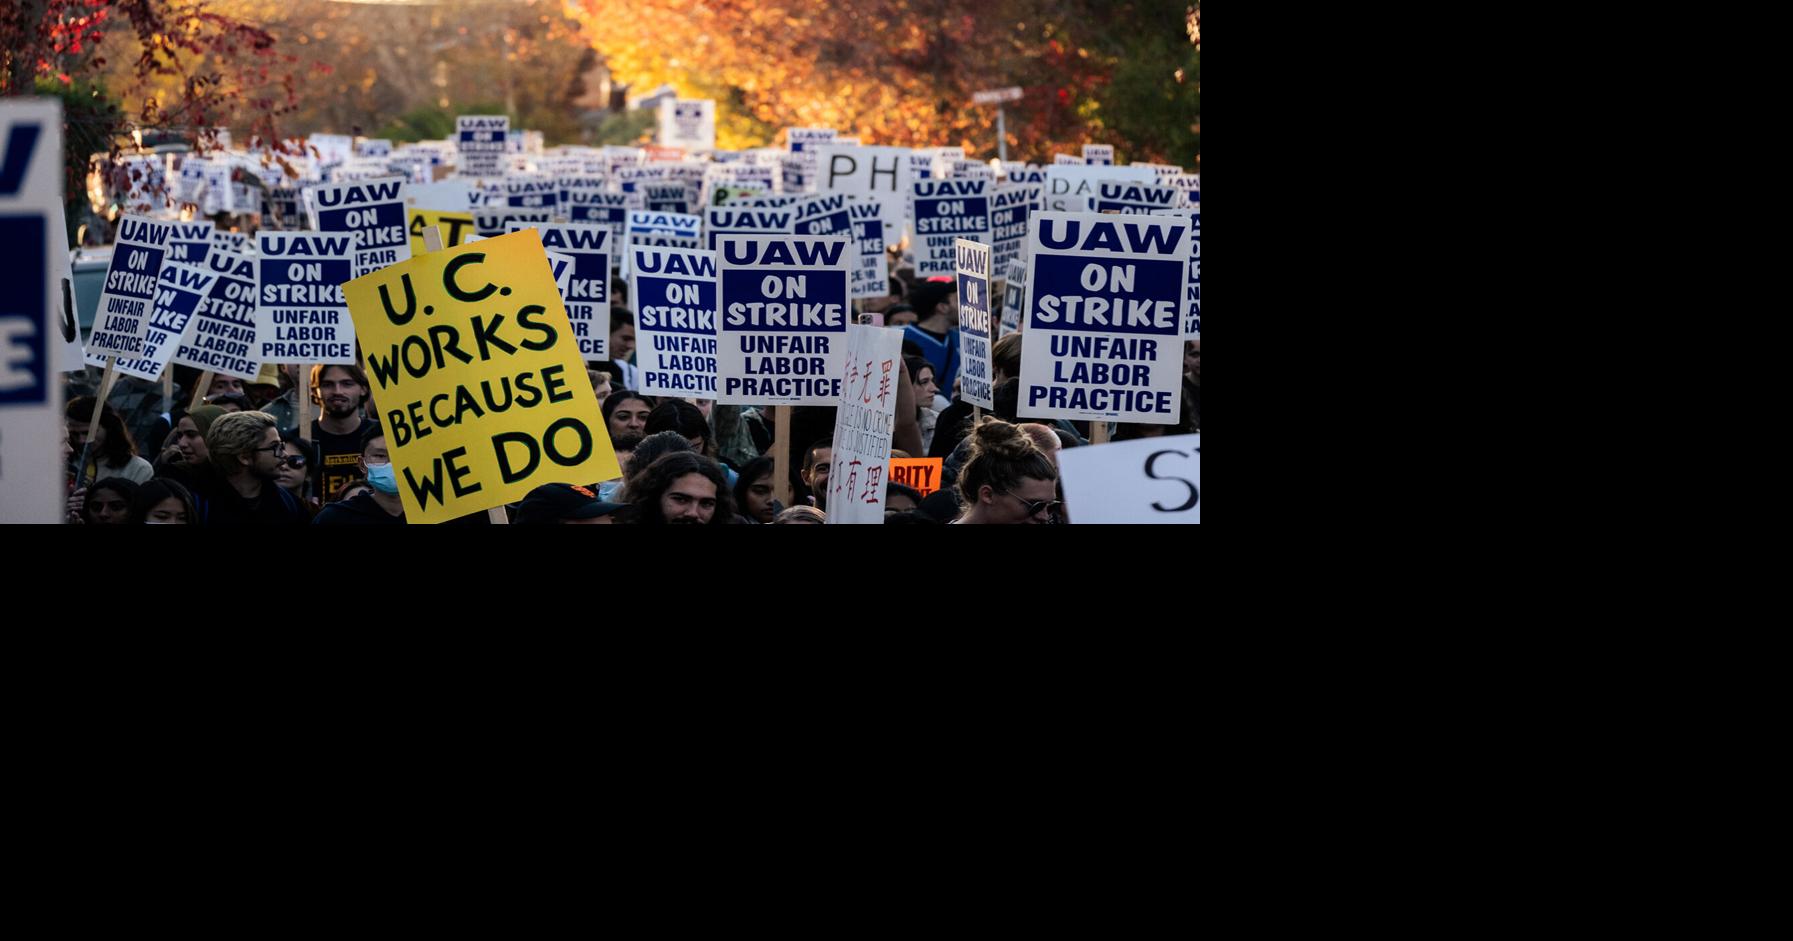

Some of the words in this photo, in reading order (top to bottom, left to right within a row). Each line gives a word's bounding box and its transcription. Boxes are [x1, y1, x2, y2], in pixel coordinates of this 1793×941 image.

[508, 181, 556, 194] UAW
[914, 180, 986, 196] UAW
[1010, 172, 1047, 183] UA
[317, 182, 402, 207] UAW
[572, 192, 626, 205] UAW
[990, 189, 1026, 208] AW
[1101, 184, 1175, 204] UAW
[345, 208, 378, 228] ON
[936, 200, 965, 216] ON
[994, 212, 1013, 224] ON
[632, 214, 696, 228] UAW
[710, 211, 791, 229] UAW
[808, 219, 834, 236] ON
[918, 216, 986, 232] STRIKE
[120, 219, 170, 246] UAW
[170, 225, 212, 240] AW
[355, 225, 404, 247] RIKE
[542, 228, 608, 250] AW
[1038, 219, 1186, 255] UAW
[261, 236, 350, 256] UAW
[724, 240, 846, 266] UAW
[930, 249, 956, 260] LAB
[128, 250, 149, 271] ON
[210, 253, 254, 280] UA
[636, 250, 717, 278] UAW
[920, 261, 956, 272] PRAC
[958, 246, 986, 274] UAW
[108, 270, 156, 295] STRIKE
[160, 266, 214, 291] AW
[287, 263, 322, 282] ON
[1080, 263, 1136, 294] ON
[224, 282, 256, 304] ON
[378, 273, 435, 325] U.
[442, 252, 512, 303] C.
[666, 282, 700, 305] ON
[760, 274, 806, 299] ON
[966, 280, 978, 304] ON
[108, 297, 145, 317] UNFAIR
[200, 296, 256, 324] STRIK
[272, 310, 339, 324] UNFAIR
[641, 306, 717, 330] STRIK
[726, 302, 842, 326] STRIKE
[1036, 294, 1176, 328] STRIKE
[104, 315, 139, 334] LABOR
[960, 305, 988, 333] STRIKE
[92, 332, 143, 353] PRACTICE
[197, 319, 256, 344] UNFAIR
[276, 327, 336, 341] LABOR
[194, 334, 249, 358] LABOR
[262, 343, 350, 358] PRACTICE
[368, 304, 558, 390] WORKS
[653, 334, 717, 354] UNFAIR
[740, 336, 830, 354] UNFAIR
[964, 336, 986, 359] UNFAIR
[1050, 335, 1158, 361] UNFAIR
[176, 345, 258, 375] PRACTICE
[658, 354, 717, 373] LABOR
[744, 356, 825, 376] LABOR
[965, 356, 986, 380] LABOR
[1054, 361, 1150, 386] LABOR
[726, 378, 841, 396] PRACTICE
[962, 376, 991, 400] PRACTICE
[388, 364, 574, 448] BECAUSE
[1028, 386, 1172, 414] PRACTICE
[402, 446, 482, 512] WE
[491, 417, 593, 484] DO
[1144, 448, 1200, 513] S
